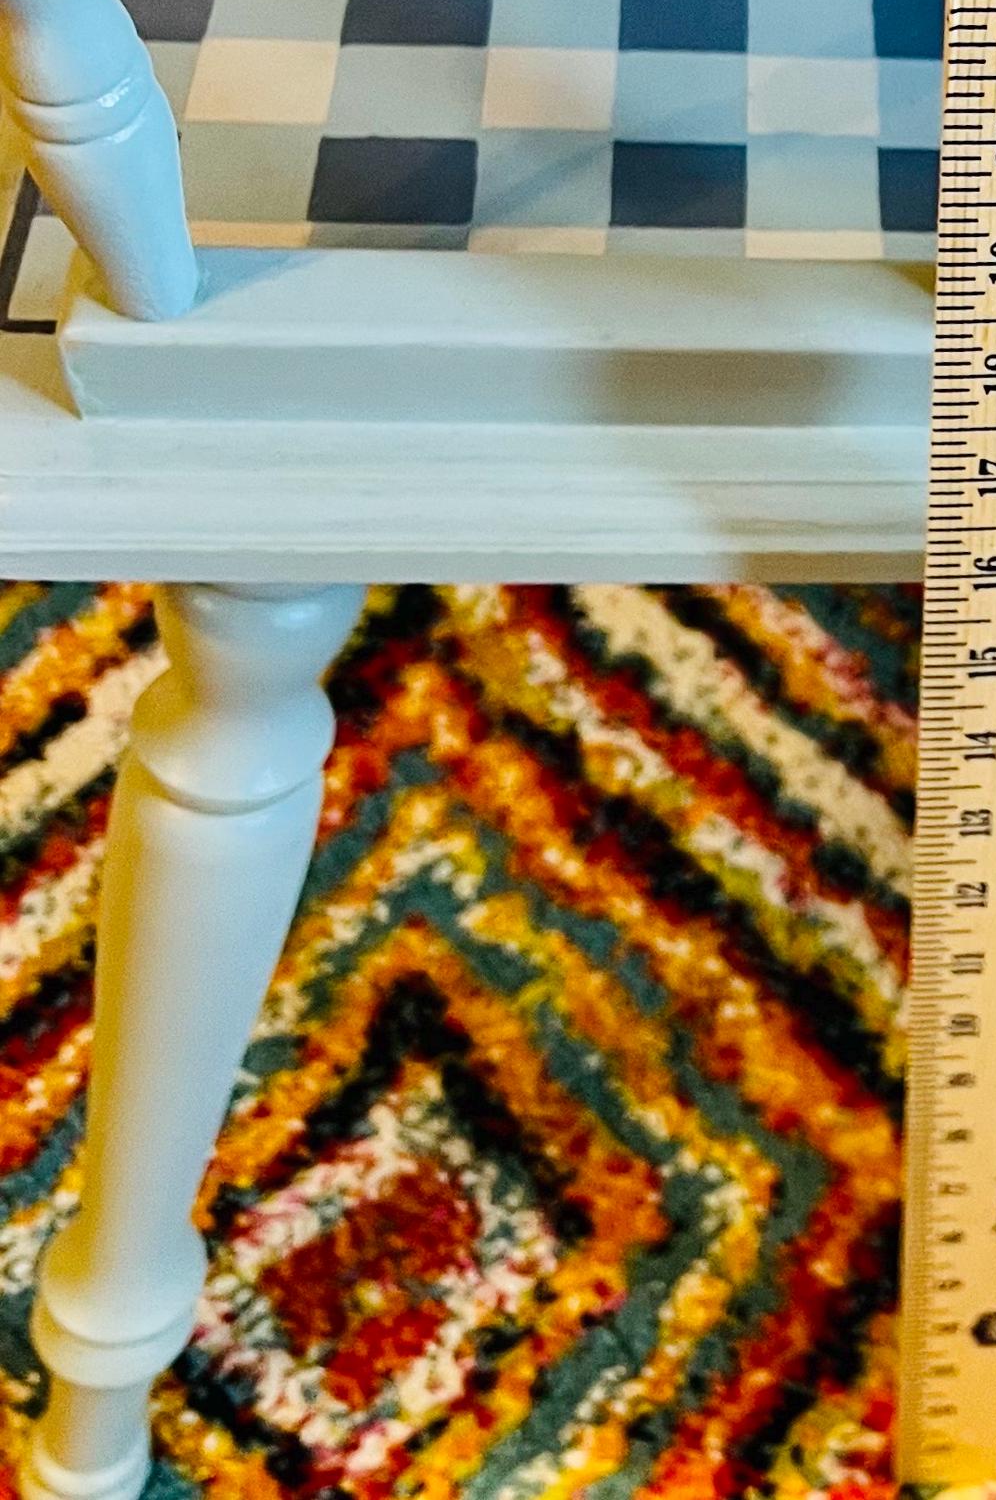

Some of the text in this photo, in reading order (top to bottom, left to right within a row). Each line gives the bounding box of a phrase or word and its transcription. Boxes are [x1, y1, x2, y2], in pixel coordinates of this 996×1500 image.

[959, 809, 992, 837] 13
[955, 882, 988, 908] 12
[951, 953, 984, 974] 11
